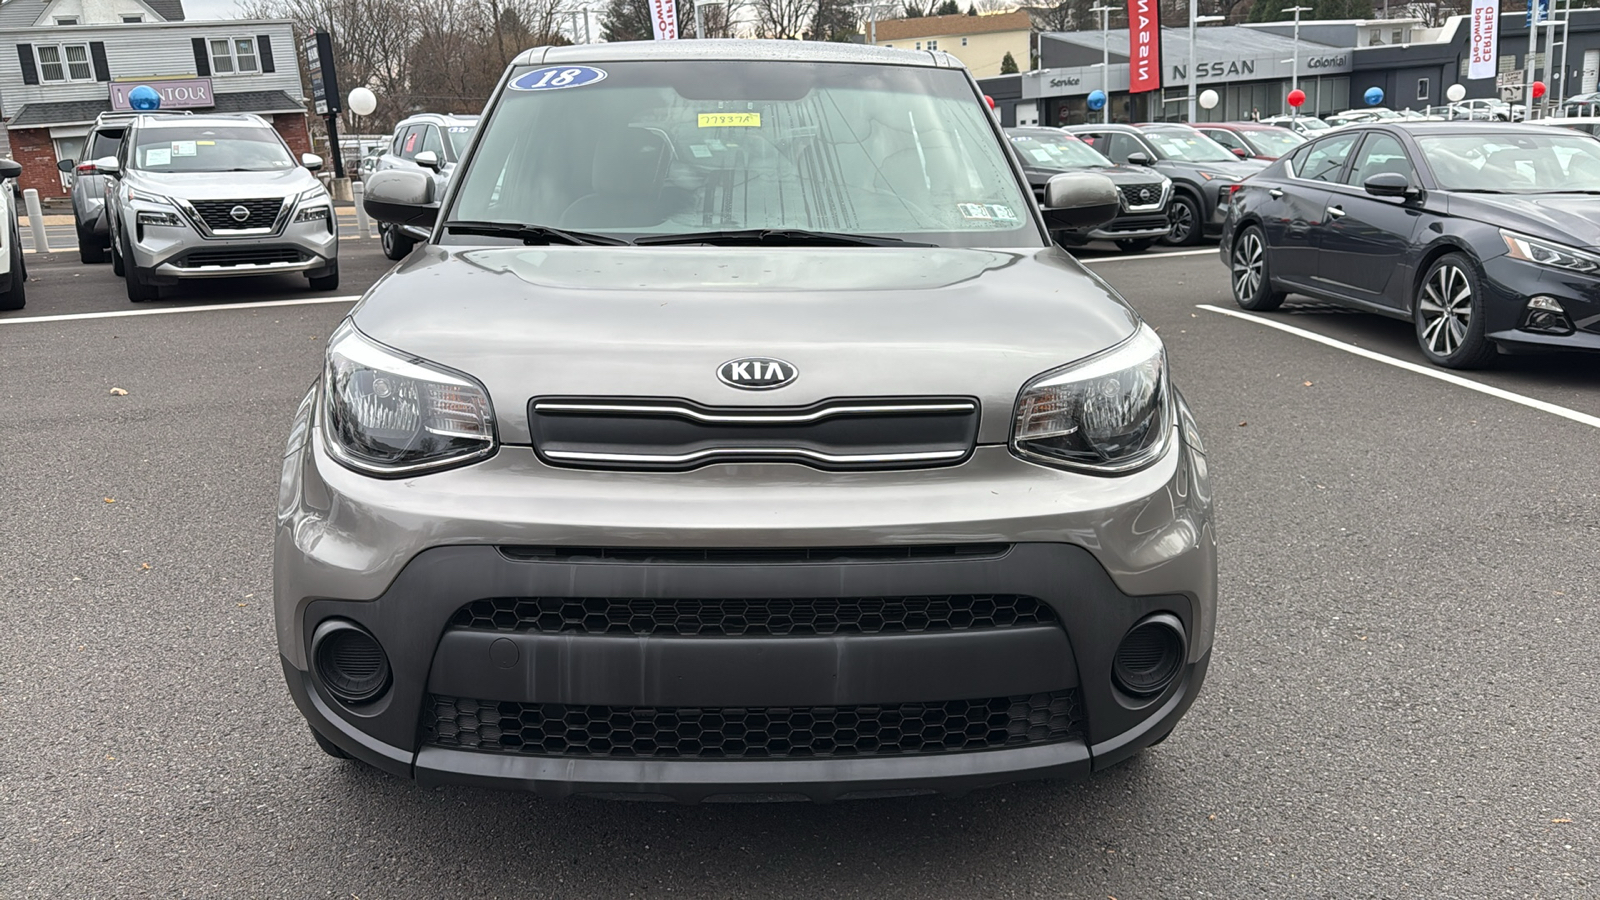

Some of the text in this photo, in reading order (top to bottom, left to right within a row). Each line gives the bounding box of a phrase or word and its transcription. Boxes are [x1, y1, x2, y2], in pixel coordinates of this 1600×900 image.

[1173, 60, 1255, 80] NSSAN
[1307, 55, 1347, 68] Colonial
[531, 68, 582, 88] 18
[1050, 76, 1080, 88] Service
[157, 86, 206, 101] NTOUR
[731, 361, 785, 381] KIA
